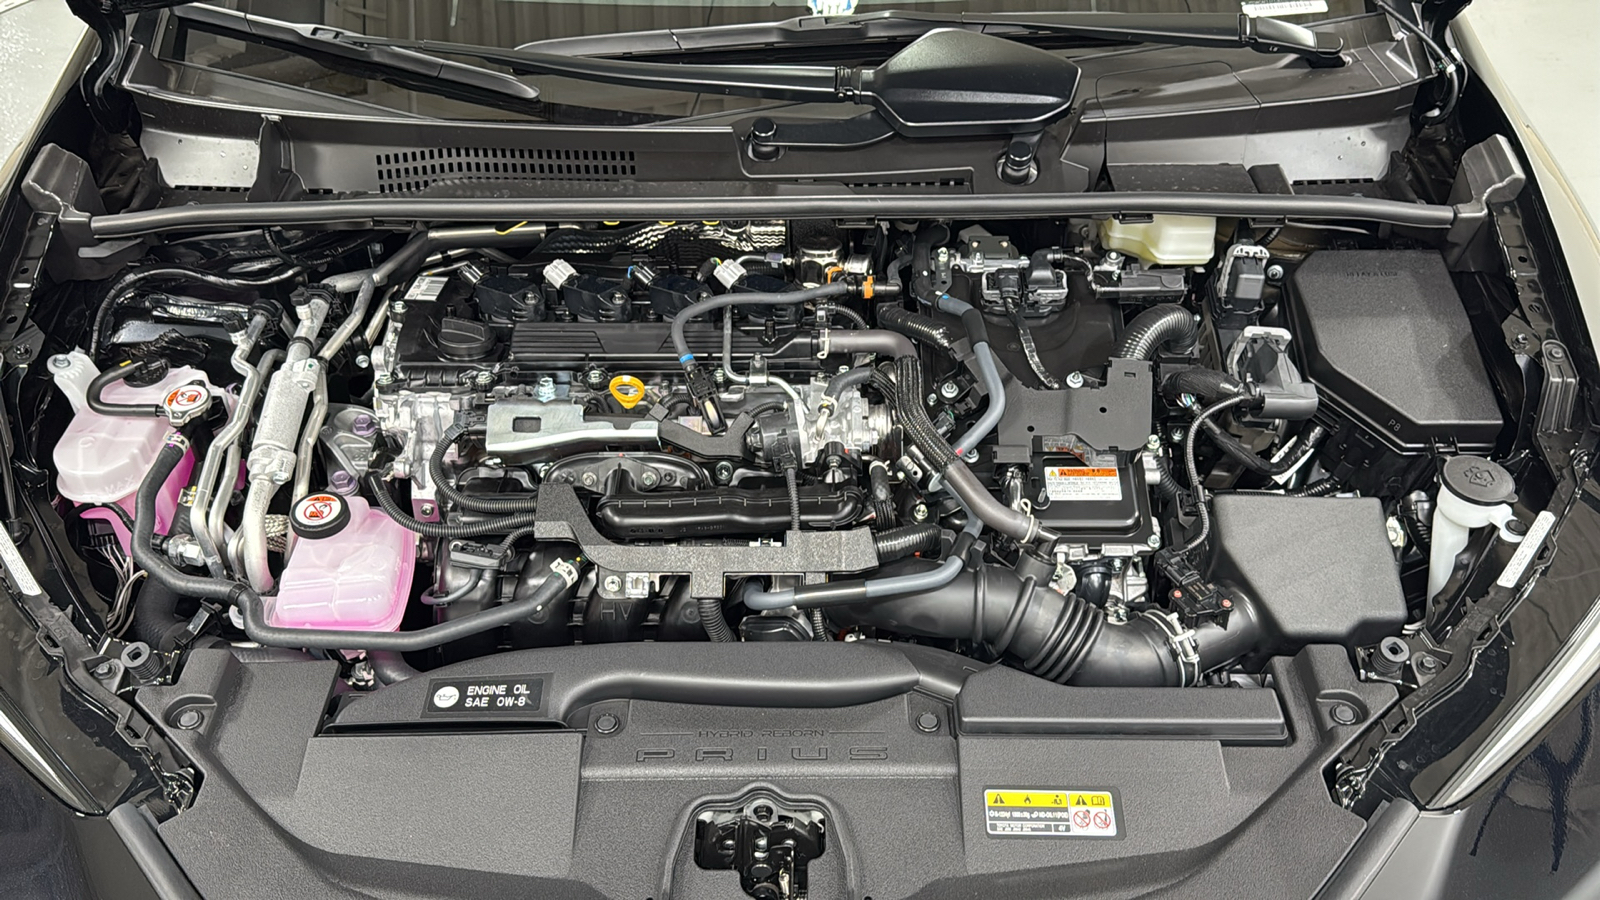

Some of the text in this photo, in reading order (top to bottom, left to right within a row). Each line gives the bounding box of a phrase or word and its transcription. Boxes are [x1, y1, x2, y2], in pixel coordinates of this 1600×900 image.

[1388, 418, 1401, 431] P8
[600, 601, 633, 620] HV
[467, 684, 530, 695] ENGINE OIL
[464, 697, 489, 707] SAE
[698, 729, 825, 738] HYBRID REBORN
[636, 746, 888, 762] PRIUS
